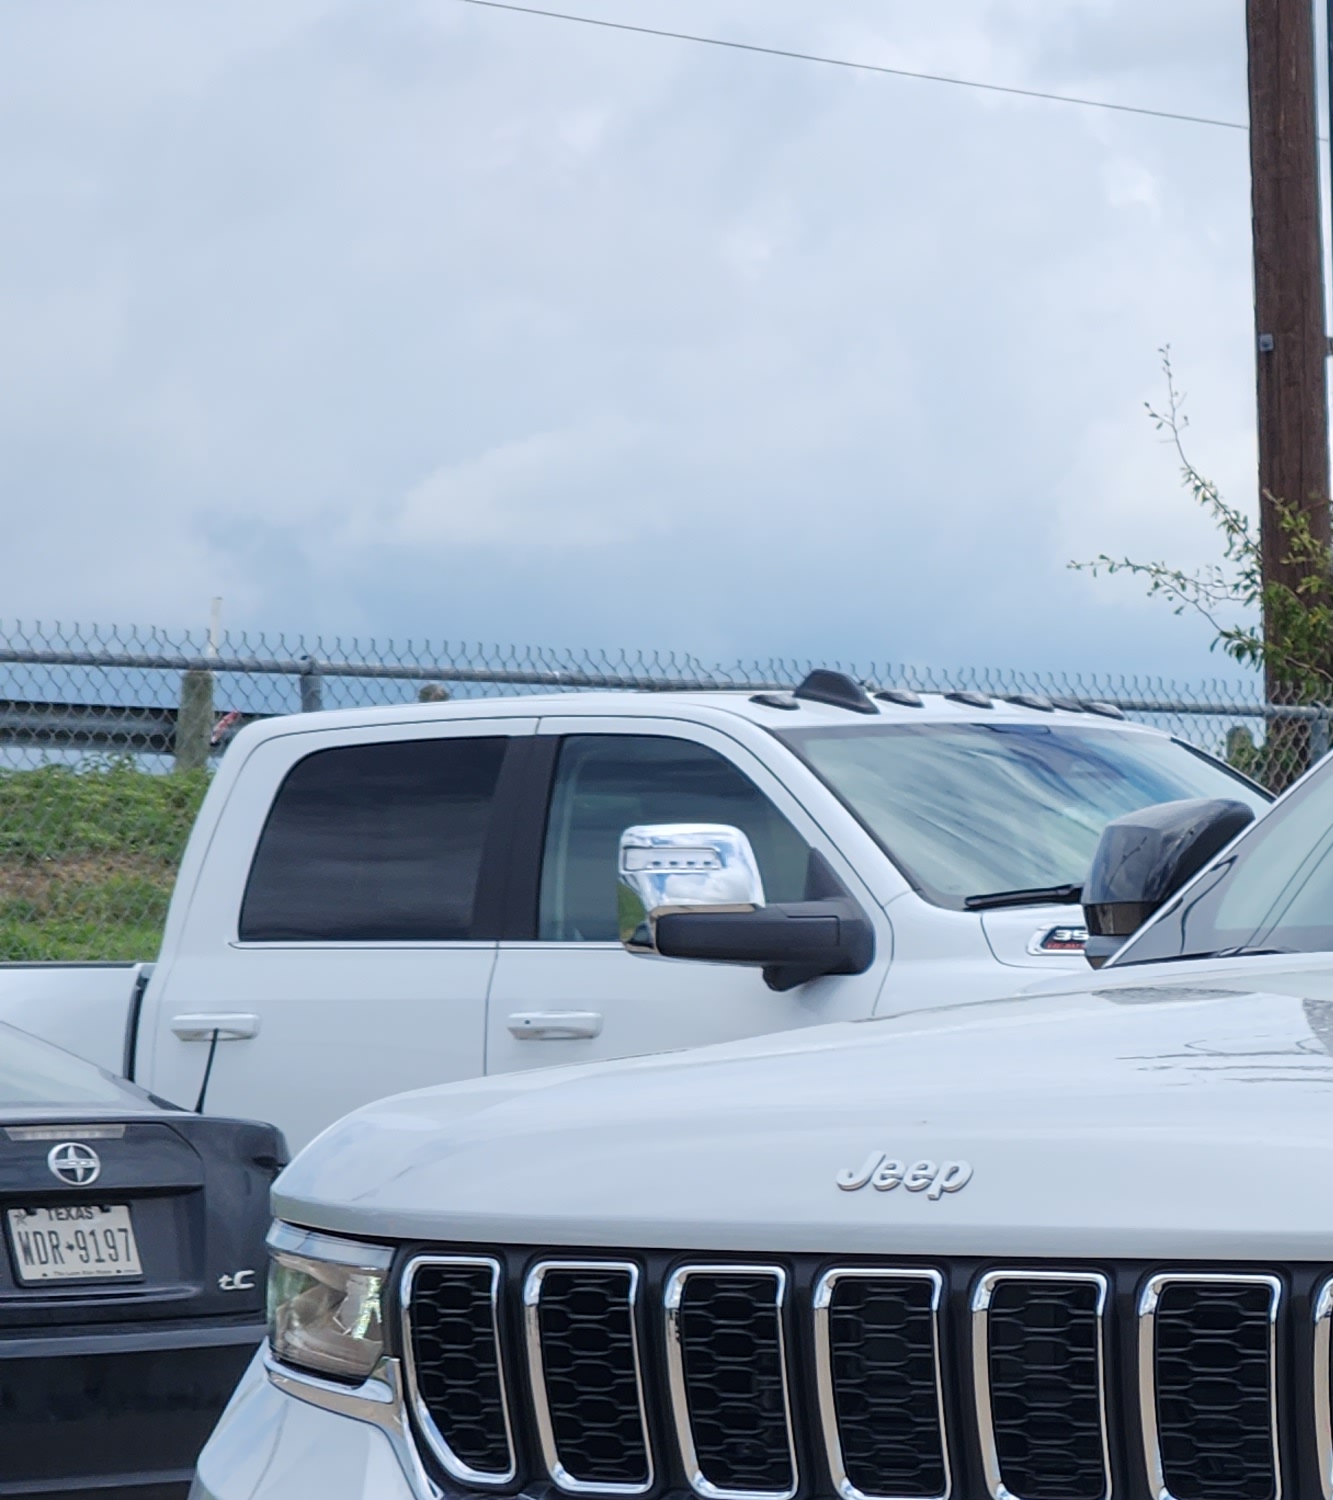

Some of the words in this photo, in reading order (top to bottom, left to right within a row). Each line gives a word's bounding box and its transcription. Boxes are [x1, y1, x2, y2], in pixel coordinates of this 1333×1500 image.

[836, 1150, 974, 1201] Jeep
[47, 1206, 94, 1221] TEXAS
[75, 1228, 131, 1264] 9197
[218, 1269, 255, 1290] tC
